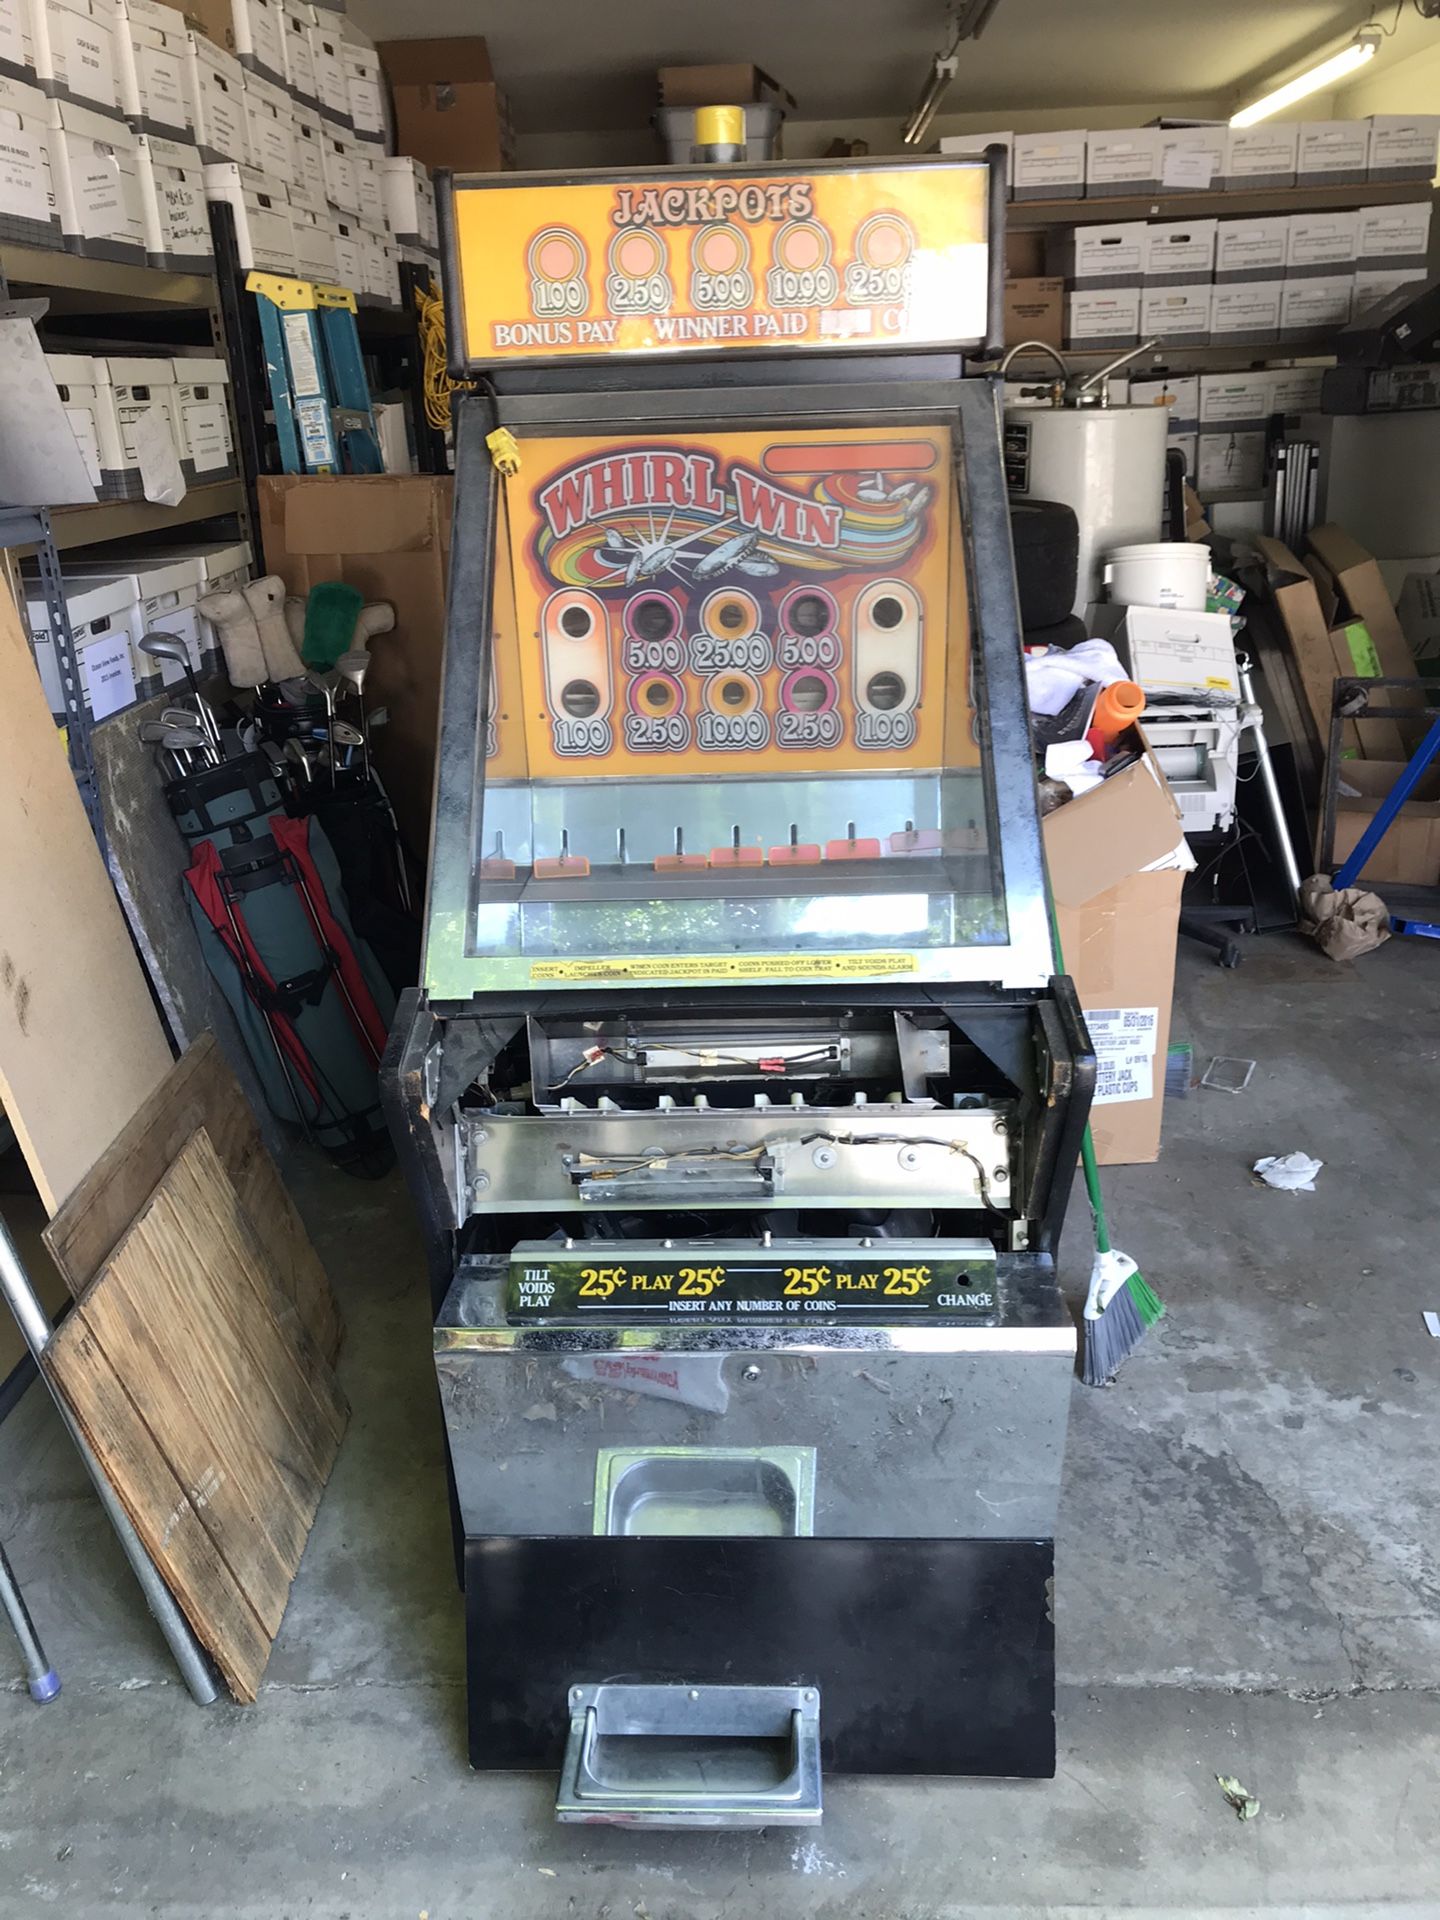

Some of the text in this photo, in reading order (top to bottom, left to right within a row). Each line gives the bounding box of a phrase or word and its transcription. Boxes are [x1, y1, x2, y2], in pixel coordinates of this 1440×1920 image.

[613, 183, 813, 226] JACKPOTS
[538, 280, 582, 311] 1.00
[614, 275, 666, 306] 2.50
[698, 272, 746, 303] 5.00
[774, 268, 832, 300] 10.00
[494, 319, 618, 346] BONUS PAY
[653, 312, 808, 341] WINNER PAID
[541, 451, 844, 548] WHIRL WIN
[628, 640, 682, 668] 5.00
[696, 637, 766, 669] 25.00
[782, 636, 835, 665] 5.00
[559, 720, 604, 750] 1.00
[630, 716, 684, 744] 2.50
[701, 713, 764, 745] 10.00
[781, 713, 836, 740] 2.50
[863, 712, 908, 742] 1.00
[1096, 1069, 1132, 1083] TTERY JACK
[1097, 1081, 1138, 1096] PLASTIC CUPS
[518, 1282, 555, 1294] VOIDS
[523, 1269, 550, 1281] TILT
[579, 1266, 726, 1297] 25¢ PLAY 25¢
[783, 1265, 932, 1296] 25¢ PLAY 25¢
[519, 1295, 552, 1307] PLAY
[668, 1300, 837, 1311] INSERT ANY NUMBER OF COINS
[937, 1292, 993, 1306] CHANGE
